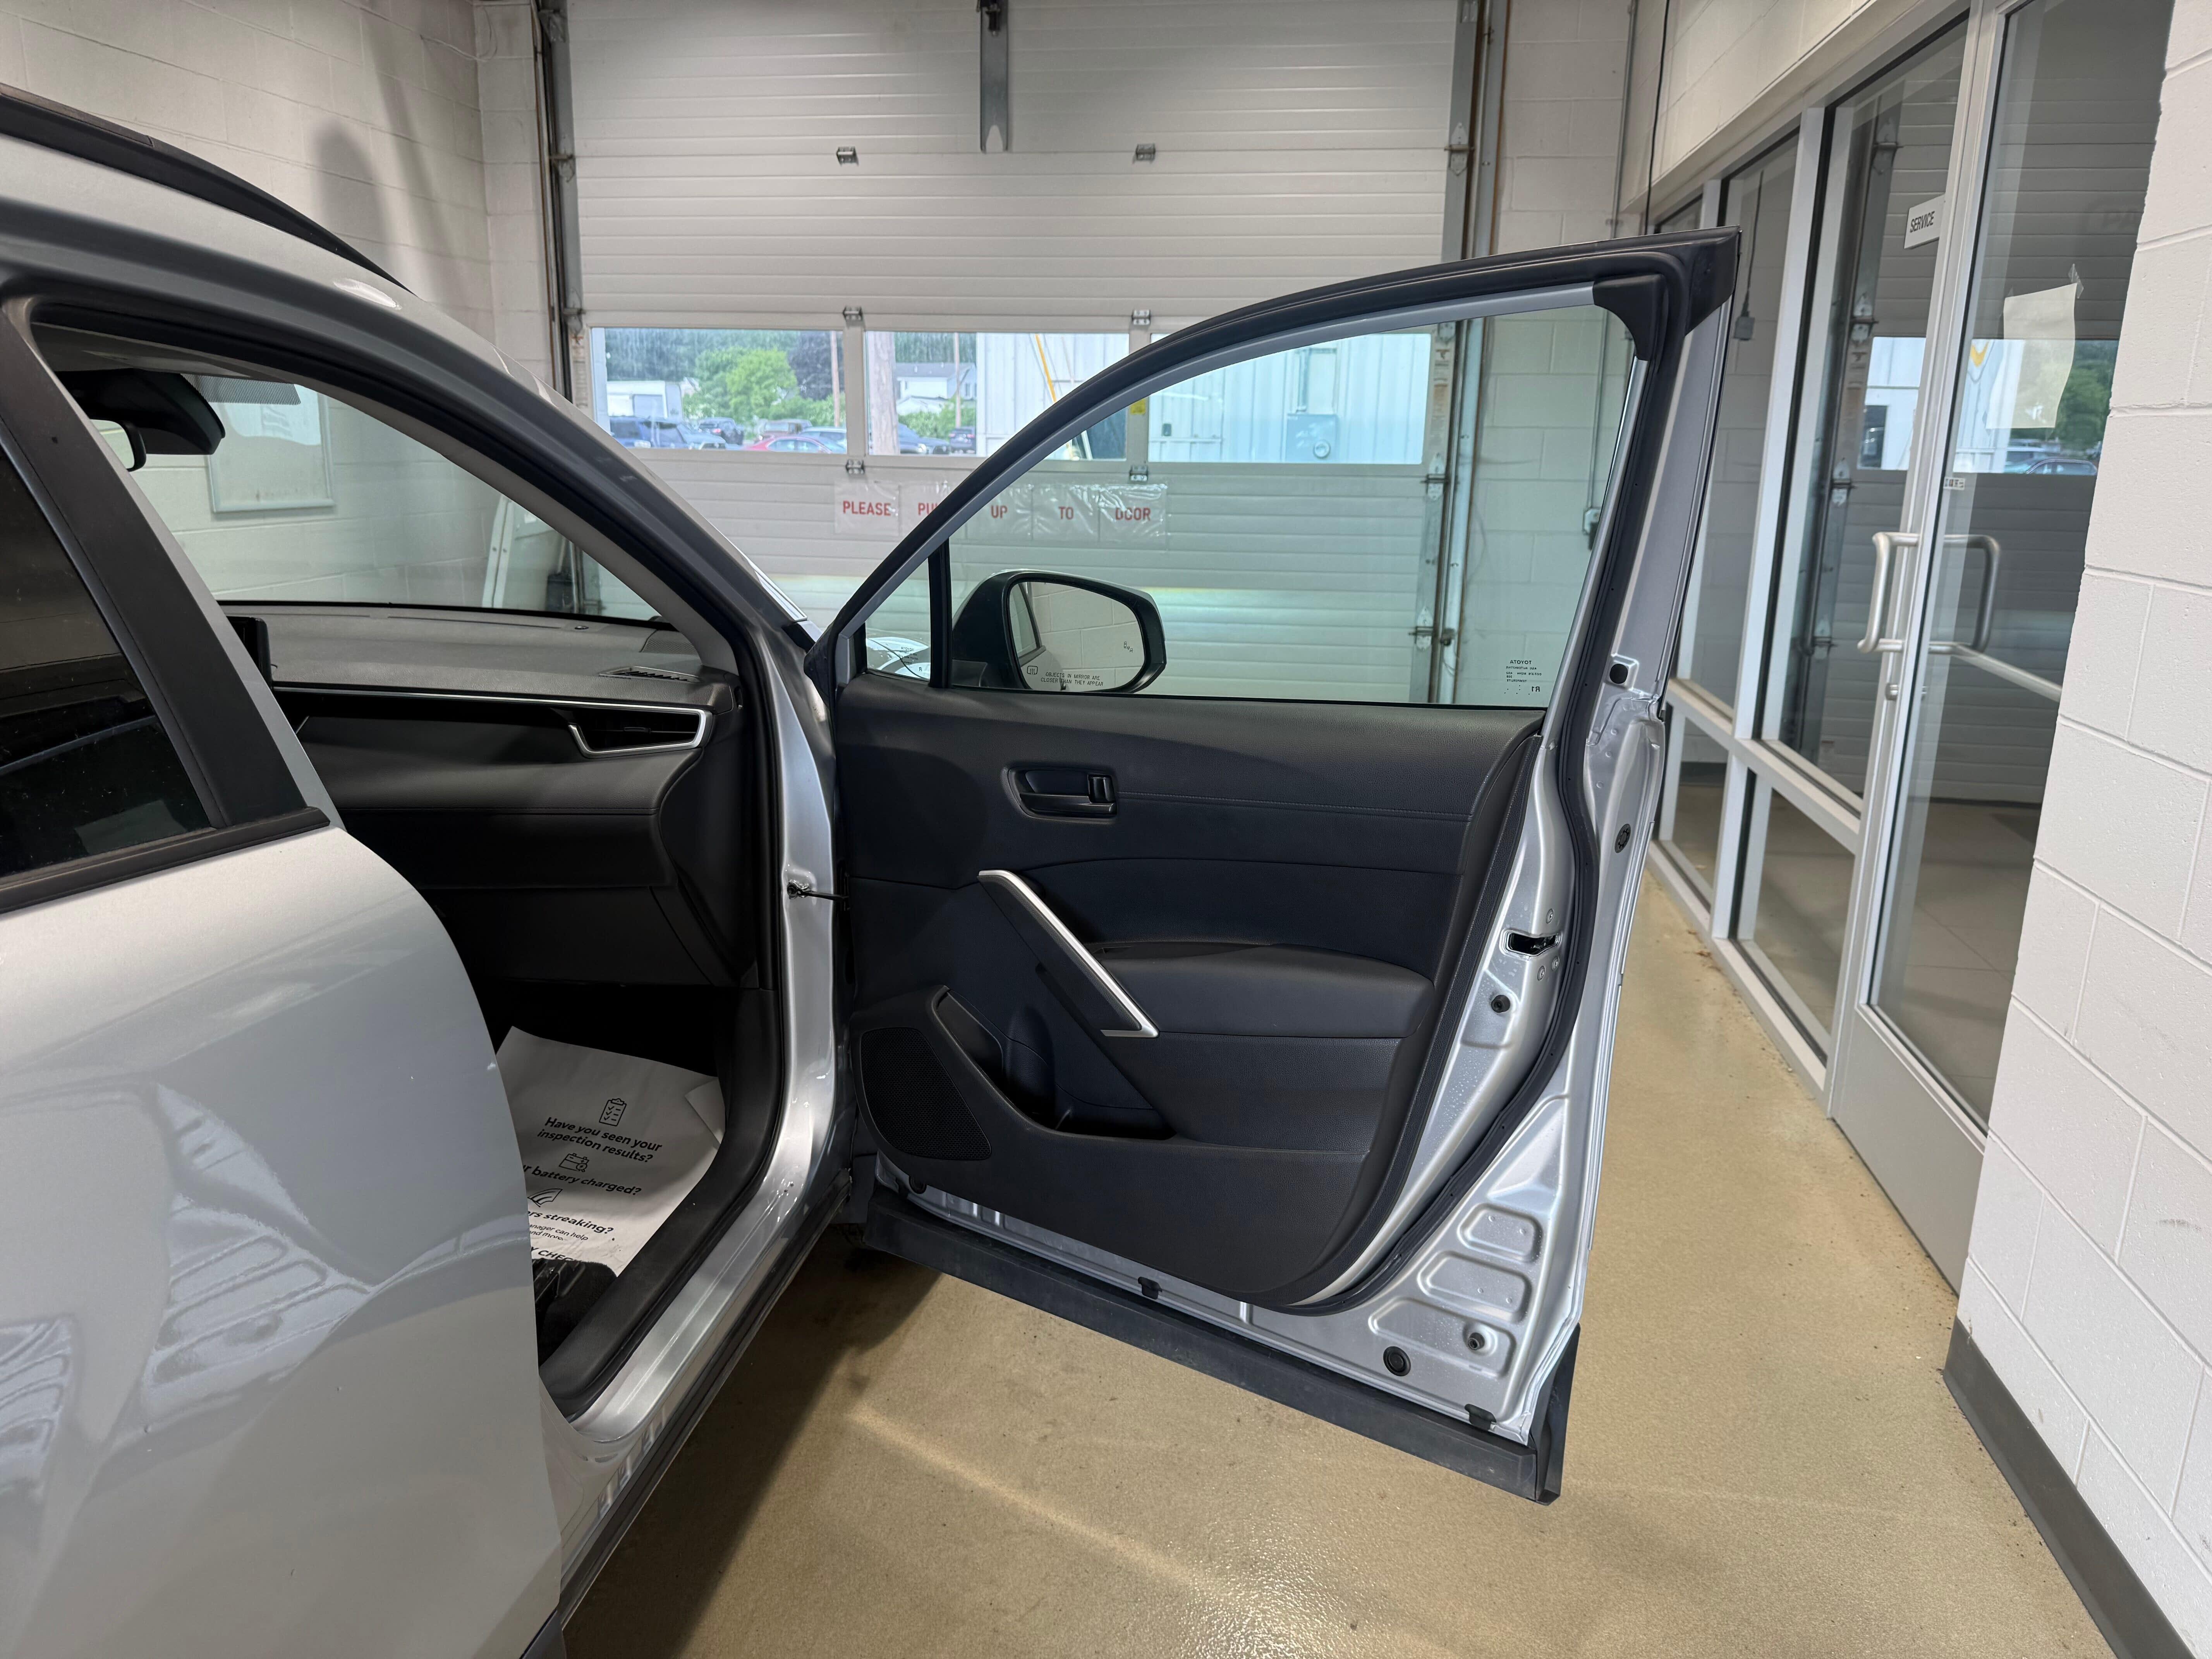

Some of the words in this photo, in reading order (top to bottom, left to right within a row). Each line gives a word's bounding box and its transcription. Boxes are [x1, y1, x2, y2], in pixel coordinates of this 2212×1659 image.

[1910, 211, 1935, 233] SERVICE
[843, 500, 891, 516] PLEASE
[917, 502, 939, 516] PU
[991, 505, 1008, 518] UP
[1058, 506, 1074, 520] TO
[1115, 507, 1151, 521] DOOR
[544, 1116, 576, 1130] Have
[575, 1126, 601, 1136] you
[601, 1132, 631, 1145] seen
[630, 1139, 663, 1152] your
[537, 1128, 602, 1150] inspection
[602, 1145, 653, 1163] results?
[532, 1166, 580, 1184] battery
[580, 1178, 642, 1195] charged?
[543, 1214, 614, 1234] streaking?
[570, 1232, 589, 1241] help
